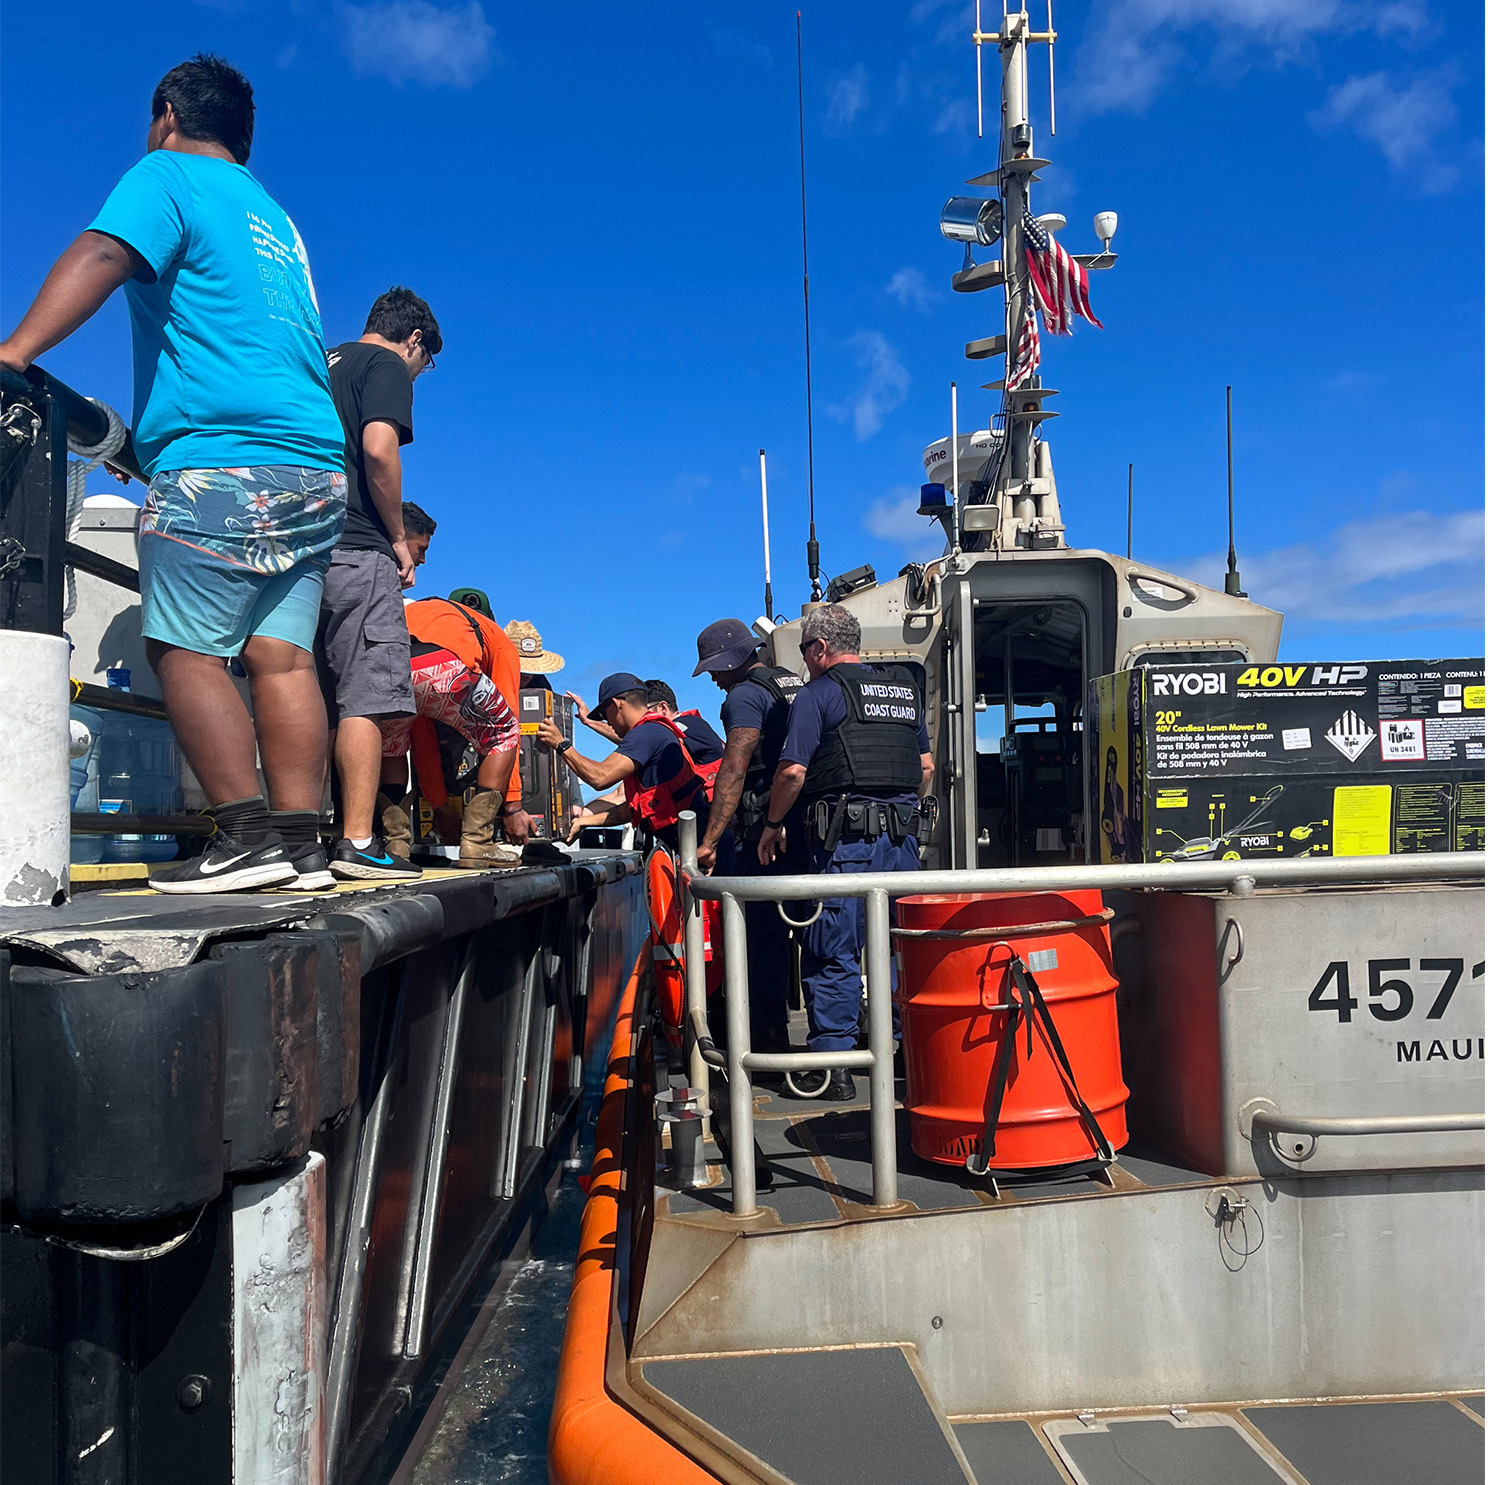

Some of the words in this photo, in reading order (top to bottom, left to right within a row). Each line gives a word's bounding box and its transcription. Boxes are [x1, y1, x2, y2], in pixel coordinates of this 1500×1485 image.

[1236, 666, 1307, 687] 40V
[1311, 665, 1368, 685] HP
[1446, 671, 1478, 679] CONTENU:
[1152, 672, 1227, 696] RYOBI
[860, 683, 889, 698] UNITED
[889, 685, 914, 701] STATES
[1237, 691, 1251, 699] High
[1132, 677, 1140, 726] RYOBI
[864, 703, 890, 718] COAST
[890, 705, 916, 720] GUARD
[1155, 711, 1181, 725] 20"
[1155, 725, 1171, 733] 40V
[1172, 724, 1205, 732] Cordless
[1229, 723, 1255, 731] Mower
[1156, 734, 1193, 742] Ensemble
[1194, 733, 1205, 741] de
[1206, 733, 1241, 741] tondeuse
[1243, 732, 1249, 740] à
[1250, 733, 1274, 742] gazon
[1156, 743, 1174, 751] sans
[1175, 742, 1184, 750] fil
[1185, 742, 1200, 750] 508
[1218, 741, 1229, 749] de
[1230, 741, 1241, 749] 40
[1157, 752, 1168, 760] Kit
[1169, 752, 1180, 760] de
[1181, 751, 1219, 760] podadora
[1221, 750, 1267, 759] inalámbrica
[1169, 760, 1184, 768] 508
[1202, 761, 1208, 769] y
[1221, 759, 1228, 767] V
[1134, 785, 1141, 822] HP
[1240, 836, 1270, 847] RYOBI
[1397, 1037, 1485, 1062] MAUI
